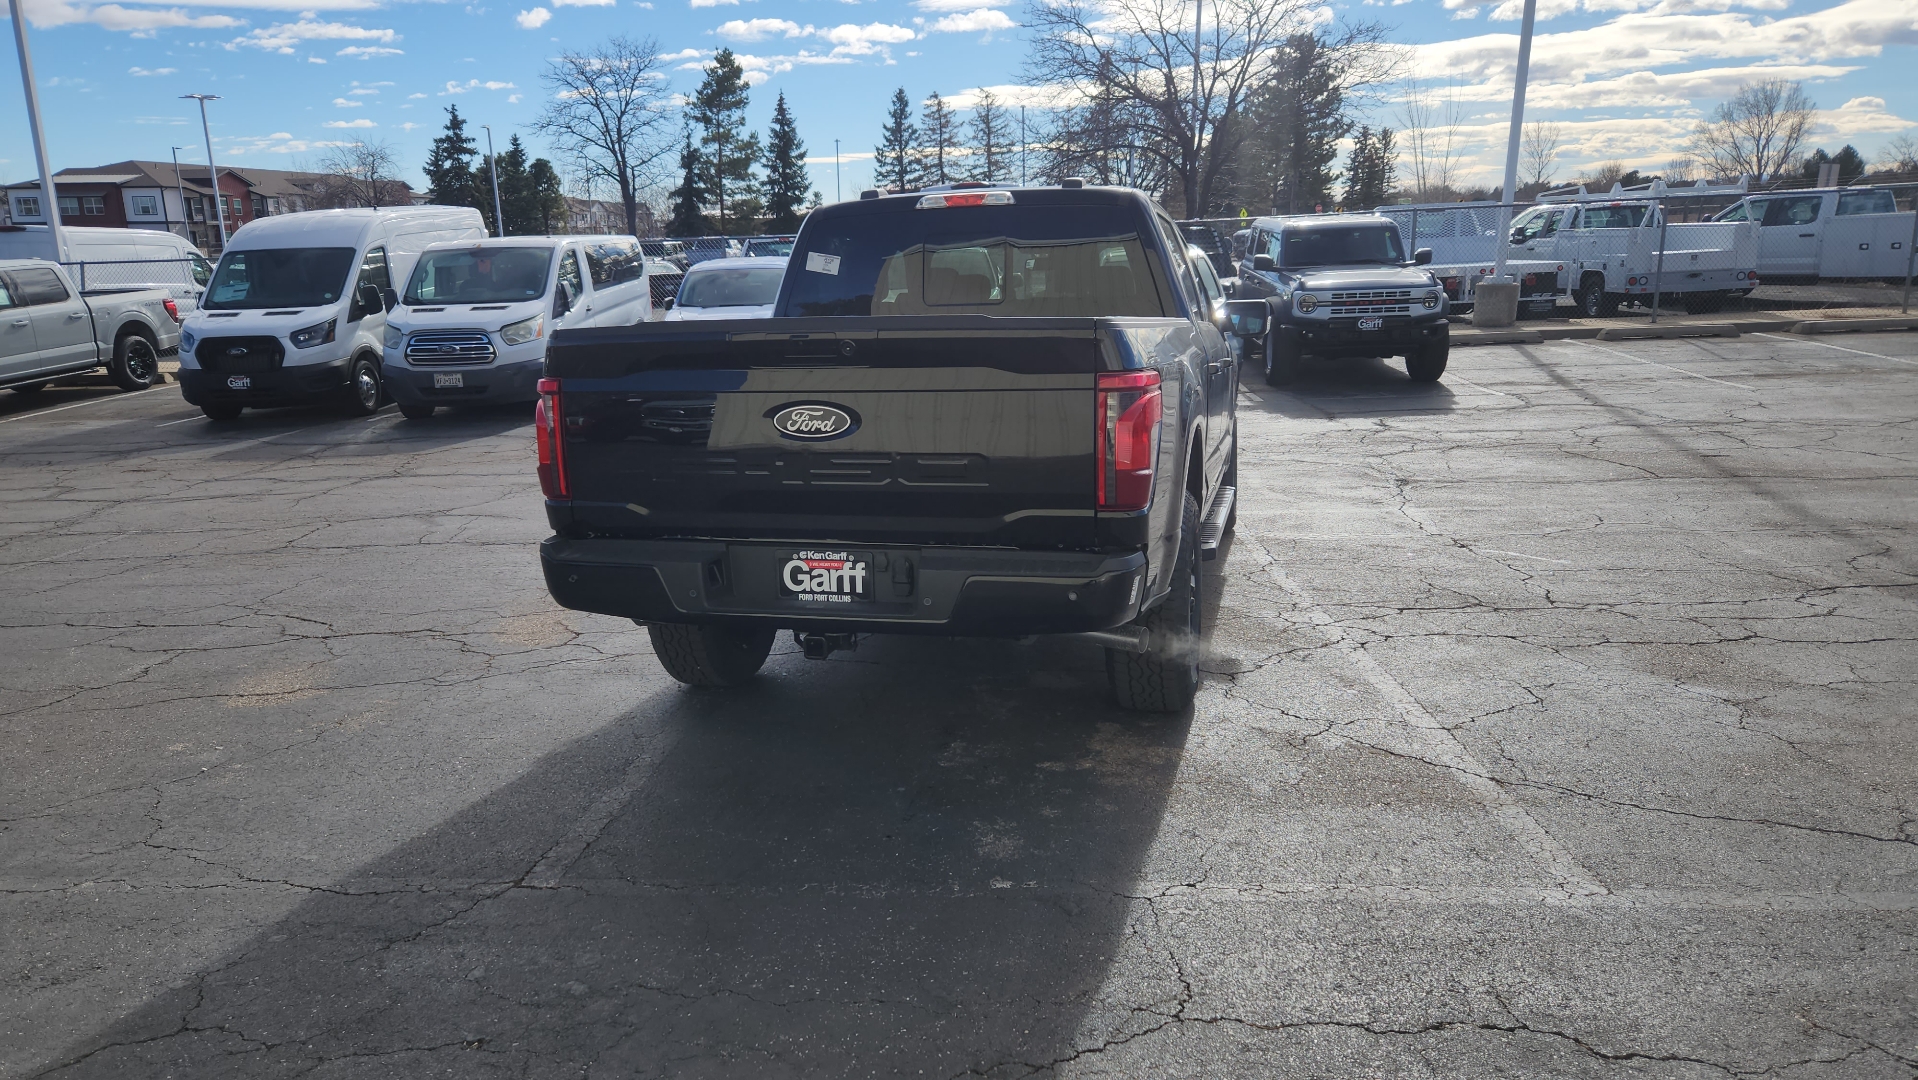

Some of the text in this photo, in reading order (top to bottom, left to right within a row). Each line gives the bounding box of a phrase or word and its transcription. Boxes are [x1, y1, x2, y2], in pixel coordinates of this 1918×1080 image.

[1357, 318, 1383, 329] Garff
[227, 377, 251, 388] Garff
[787, 410, 836, 431] Ford
[807, 551, 847, 561] Ken Garff
[783, 560, 865, 593] Garff
[798, 593, 852, 603] FORD FORT COLLINS
